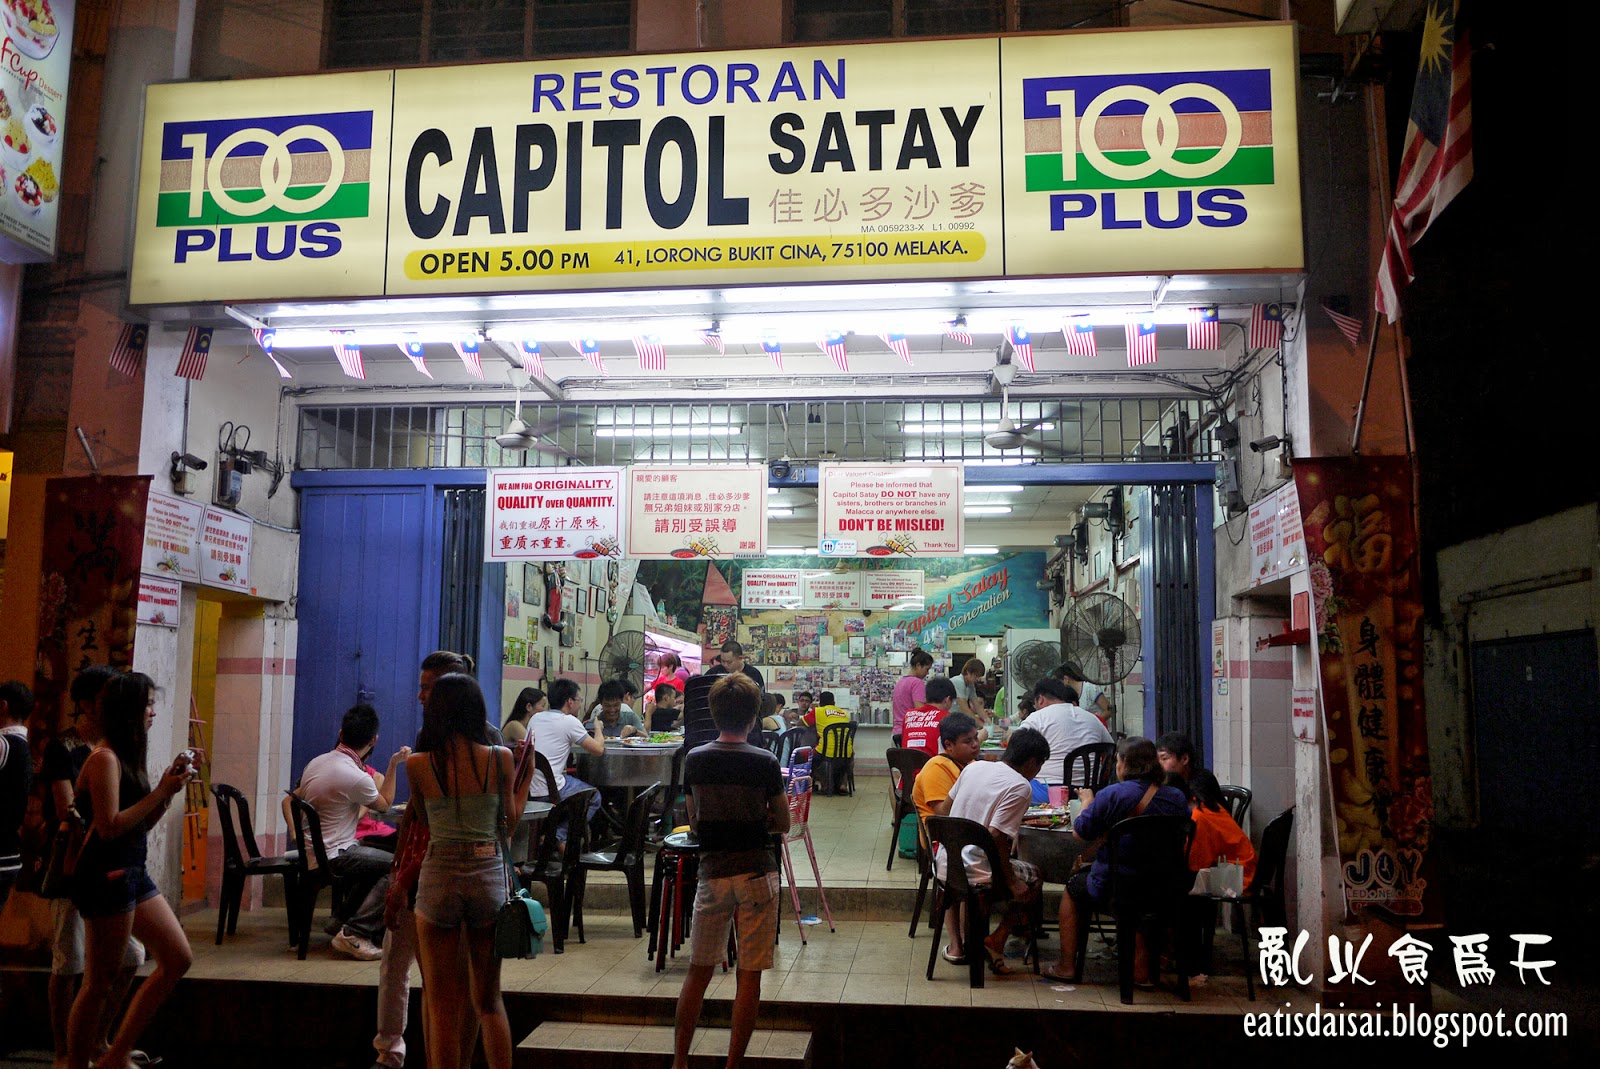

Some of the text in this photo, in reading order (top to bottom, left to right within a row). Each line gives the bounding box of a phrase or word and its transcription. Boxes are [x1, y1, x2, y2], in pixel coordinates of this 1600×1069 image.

[532, 58, 846, 113] RESTORAN
[1046, 82, 1243, 182] 100
[181, 124, 345, 218] 100
[405, 105, 985, 240] CAPITOL SATAY
[768, 182, 986, 224] 佳必多沙爹
[1050, 188, 1248, 231] PLUS
[174, 222, 342, 264] PLUS
[860, 225, 875, 233] MA
[878, 223, 924, 233] 0059233-X
[948, 222, 975, 231] 00992
[420, 240, 968, 274] OPEN 5.00 PM 41, LORONG BUKIT CINA, 75100 MELAKA.
[521, 482, 533, 490] FOR
[535, 480, 614, 490] ORIGINALITY,
[791, 468, 805, 482] 41
[498, 496, 615, 510] QUALITY OVER QUANTITY.
[860, 491, 878, 499] Satay
[897, 490, 917, 498] NOT
[654, 518, 738, 533] 請別受誤導
[839, 518, 945, 531] DON'T BE MISLED!
[739, 541, 756, 549] 謝謝
[948, 589, 1013, 631] Generation
[1345, 851, 1419, 886] JOY
